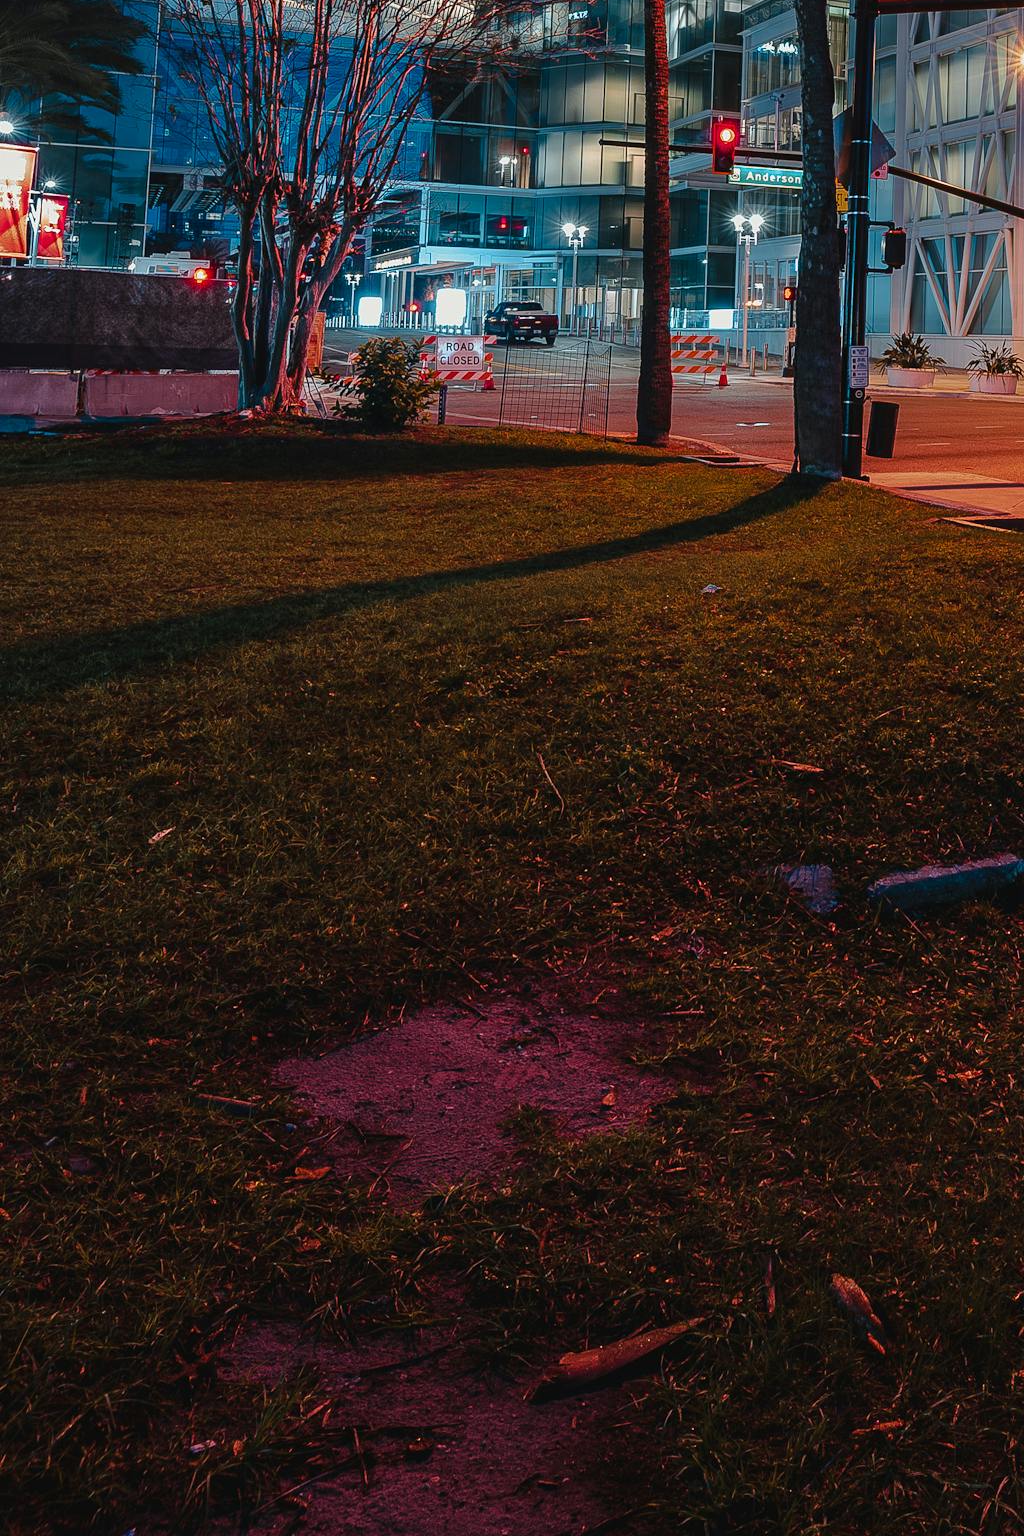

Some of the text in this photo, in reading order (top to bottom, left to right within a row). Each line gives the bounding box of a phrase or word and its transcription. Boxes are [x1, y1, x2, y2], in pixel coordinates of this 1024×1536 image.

[746, 171, 801, 184] Anderson
[446, 343, 474, 351] ROAD
[440, 356, 480, 365] CLOSED
